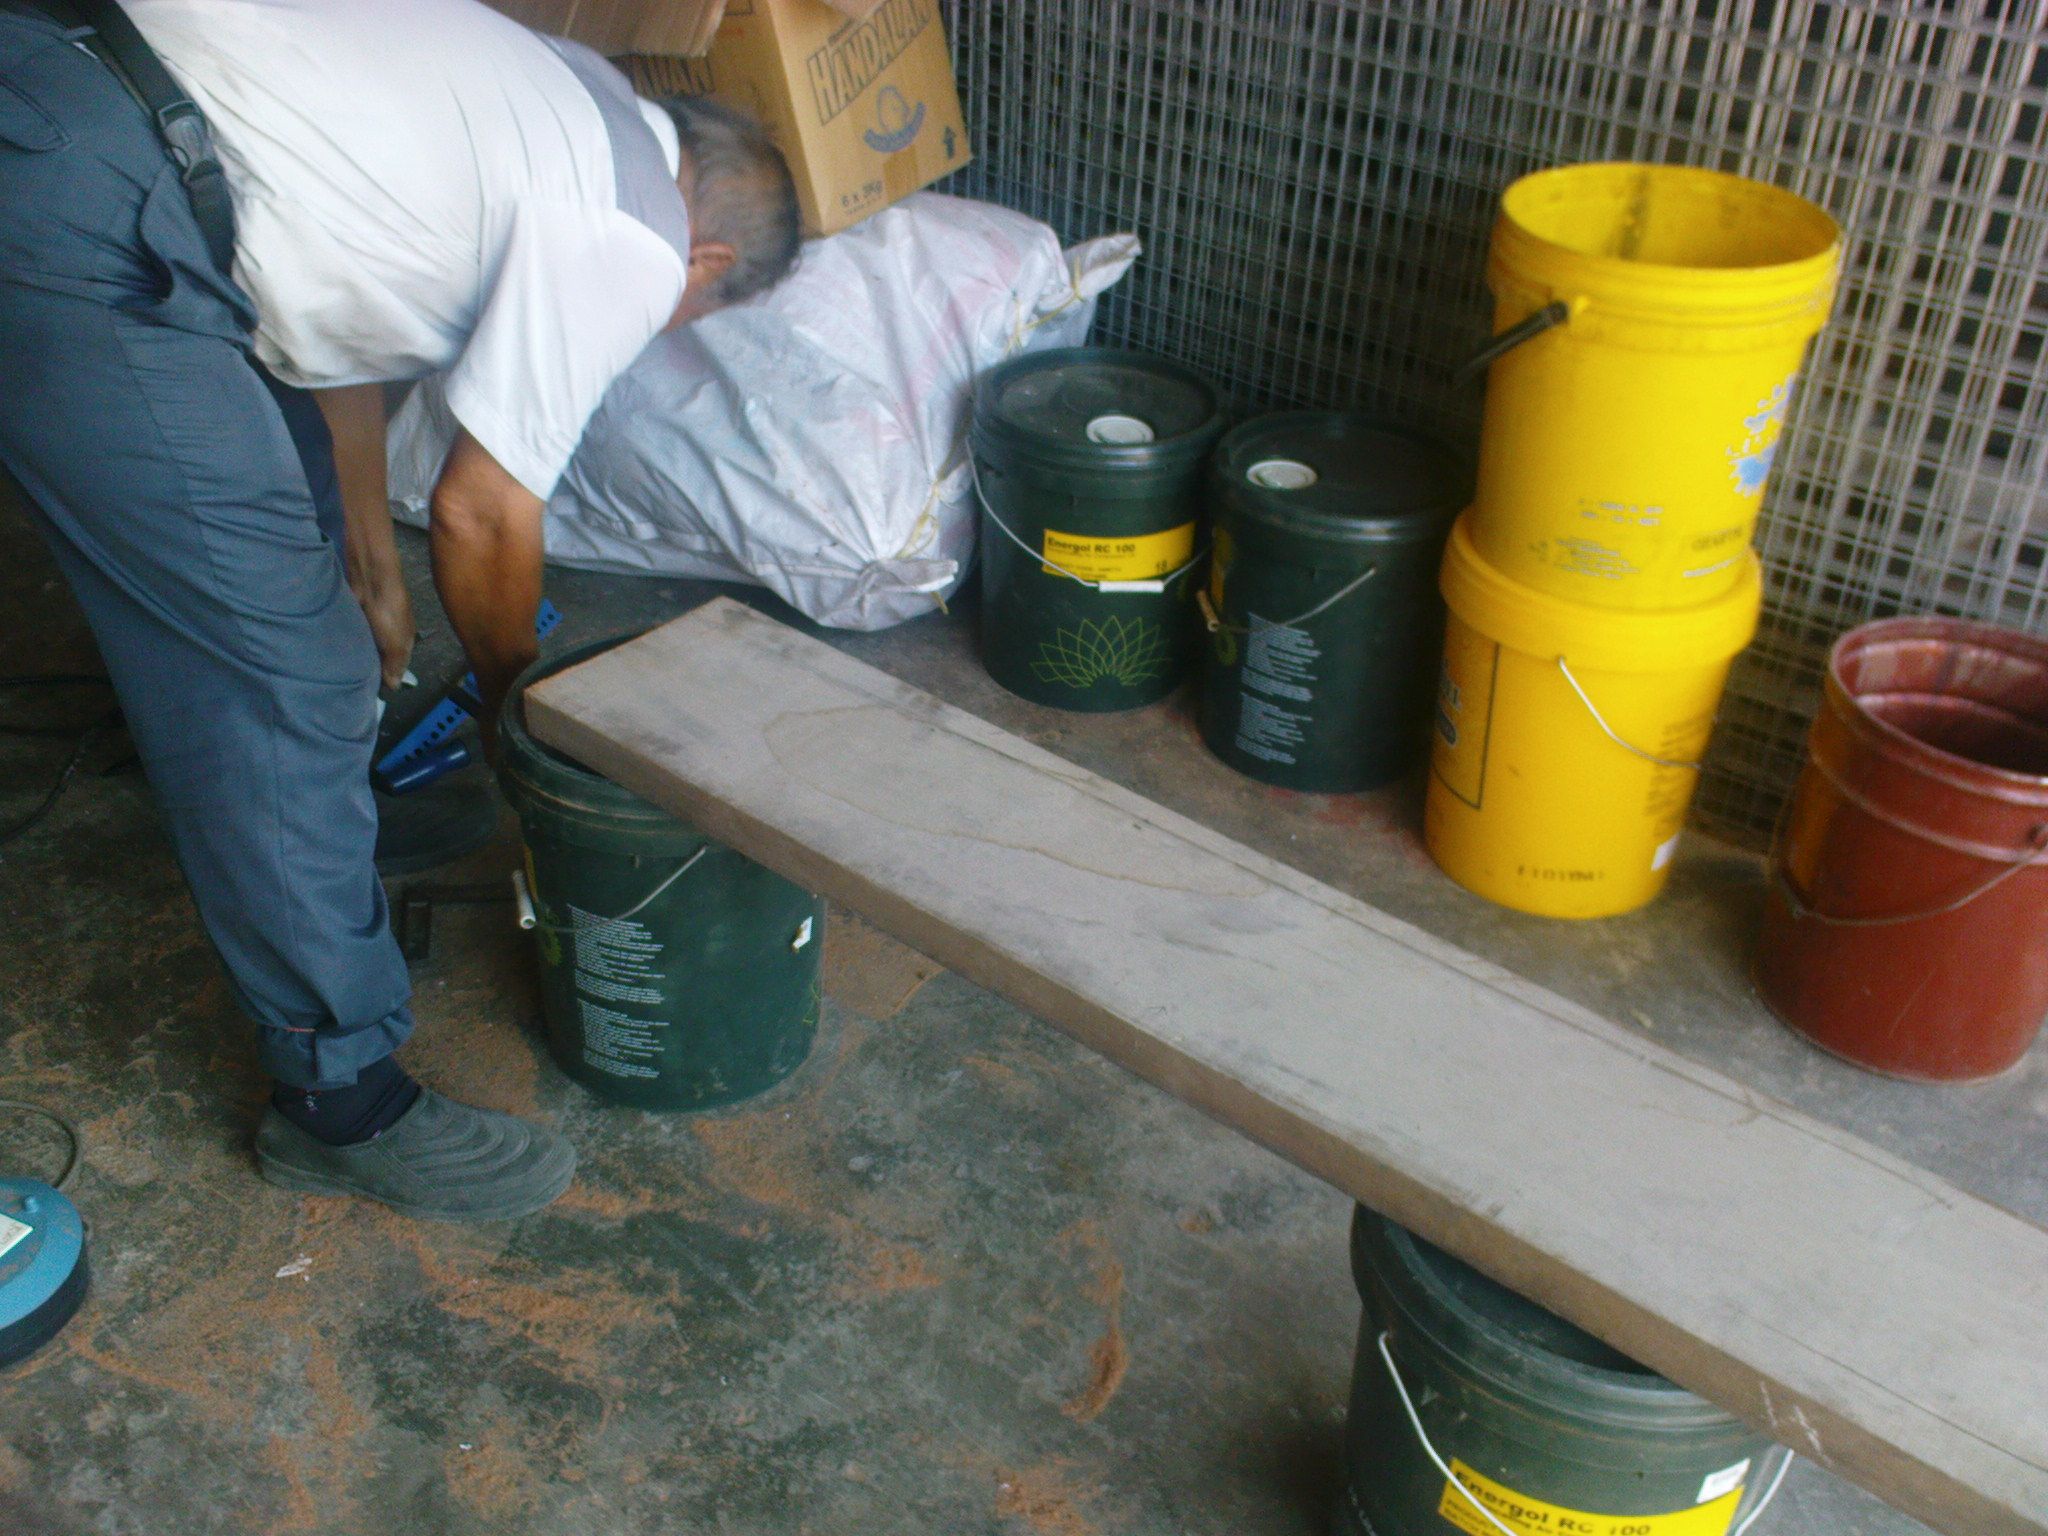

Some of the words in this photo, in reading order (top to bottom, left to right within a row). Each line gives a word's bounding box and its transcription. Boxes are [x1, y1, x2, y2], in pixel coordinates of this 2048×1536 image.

[1047, 537, 1090, 554] Energol
[1094, 543, 1111, 553] RC
[1115, 543, 1136, 553] 100
[1454, 1470, 1548, 1524] Energol
[1559, 1517, 1594, 1534] RC
[1609, 1524, 1652, 1536] 100
